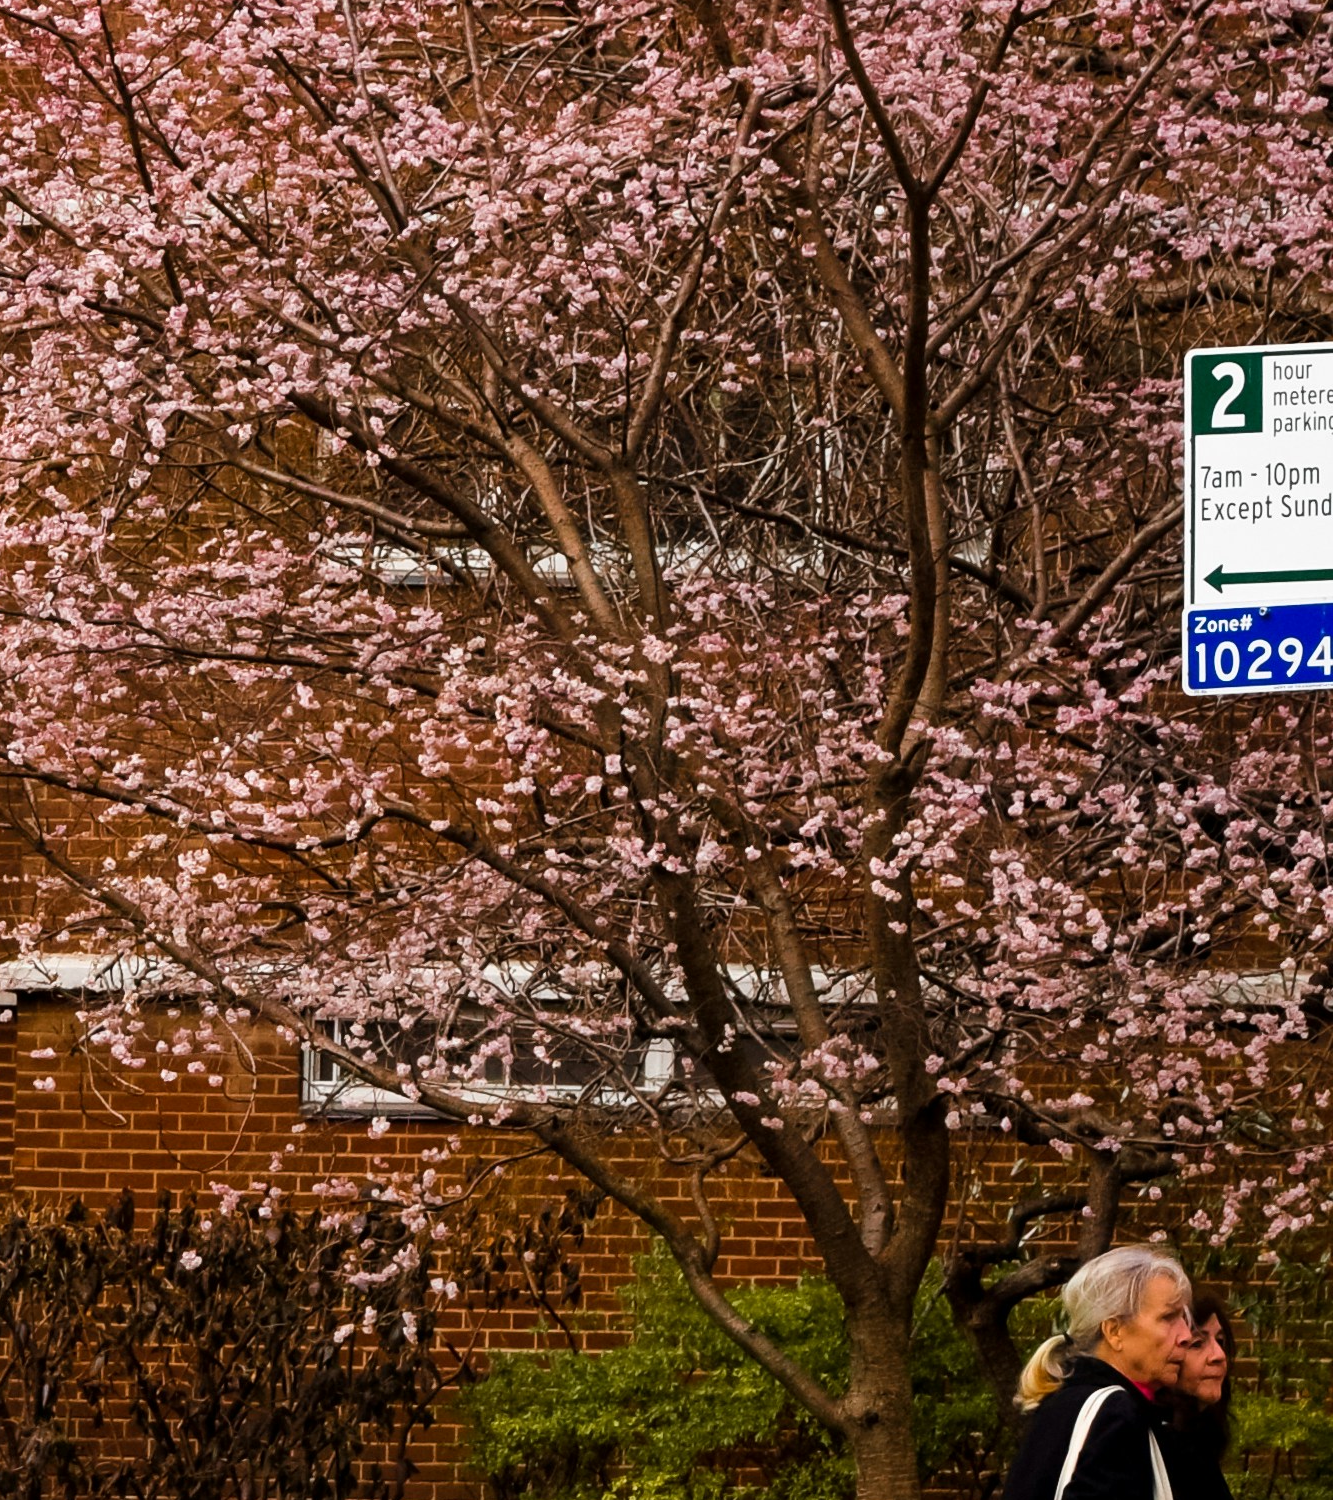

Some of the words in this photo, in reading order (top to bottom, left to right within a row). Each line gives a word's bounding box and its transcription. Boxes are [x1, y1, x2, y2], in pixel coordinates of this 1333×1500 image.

[1211, 361, 1246, 429] 2
[1273, 361, 1313, 381] hour
[1273, 385, 1333, 407] metere
[1200, 465, 1242, 489] 7am
[1265, 462, 1320, 491] 10pm
[1201, 495, 1273, 525] Except
[1281, 492, 1332, 518] Sund
[1194, 613, 1253, 634] Zone#
[1195, 635, 1333, 683] 10294
